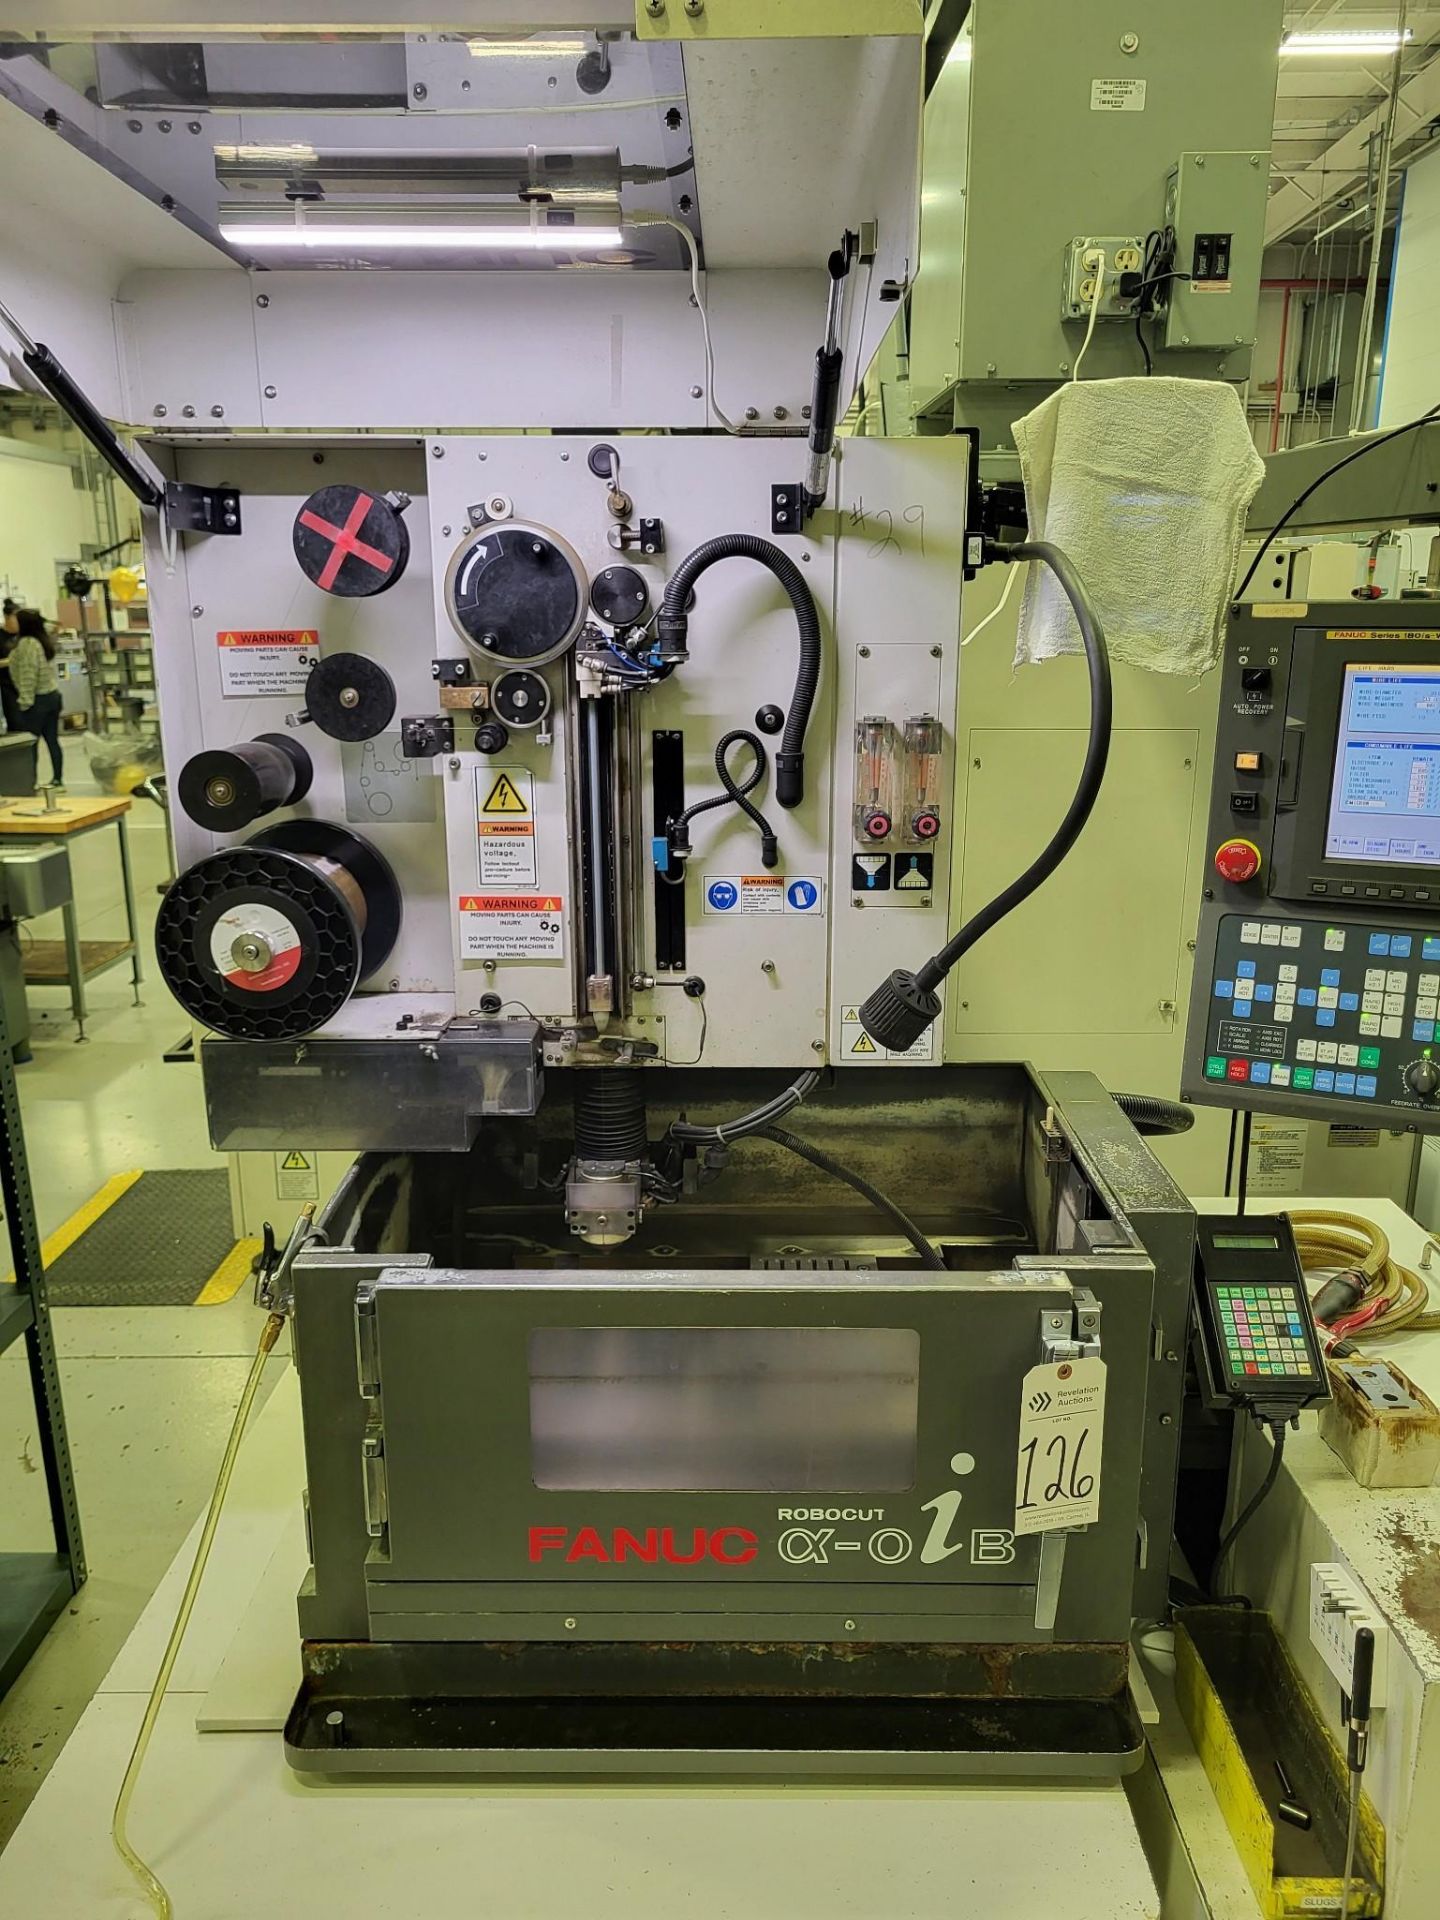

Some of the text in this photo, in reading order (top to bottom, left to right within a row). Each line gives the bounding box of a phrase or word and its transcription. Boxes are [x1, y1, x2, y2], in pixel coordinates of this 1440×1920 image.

[240, 633, 295, 643] WARNING
[482, 900, 538, 909] WARNING
[1391, 1099, 1420, 1108] FEEDRATE
[1057, 1385, 1099, 1398] Revelation
[1057, 1395, 1094, 1407] Auctions
[1016, 1428, 1094, 1510] 126
[778, 1508, 884, 1521] ROBOCUT
[528, 1526, 759, 1564] FANUC
[1304, 1898, 1337, 1906] SLUGS
